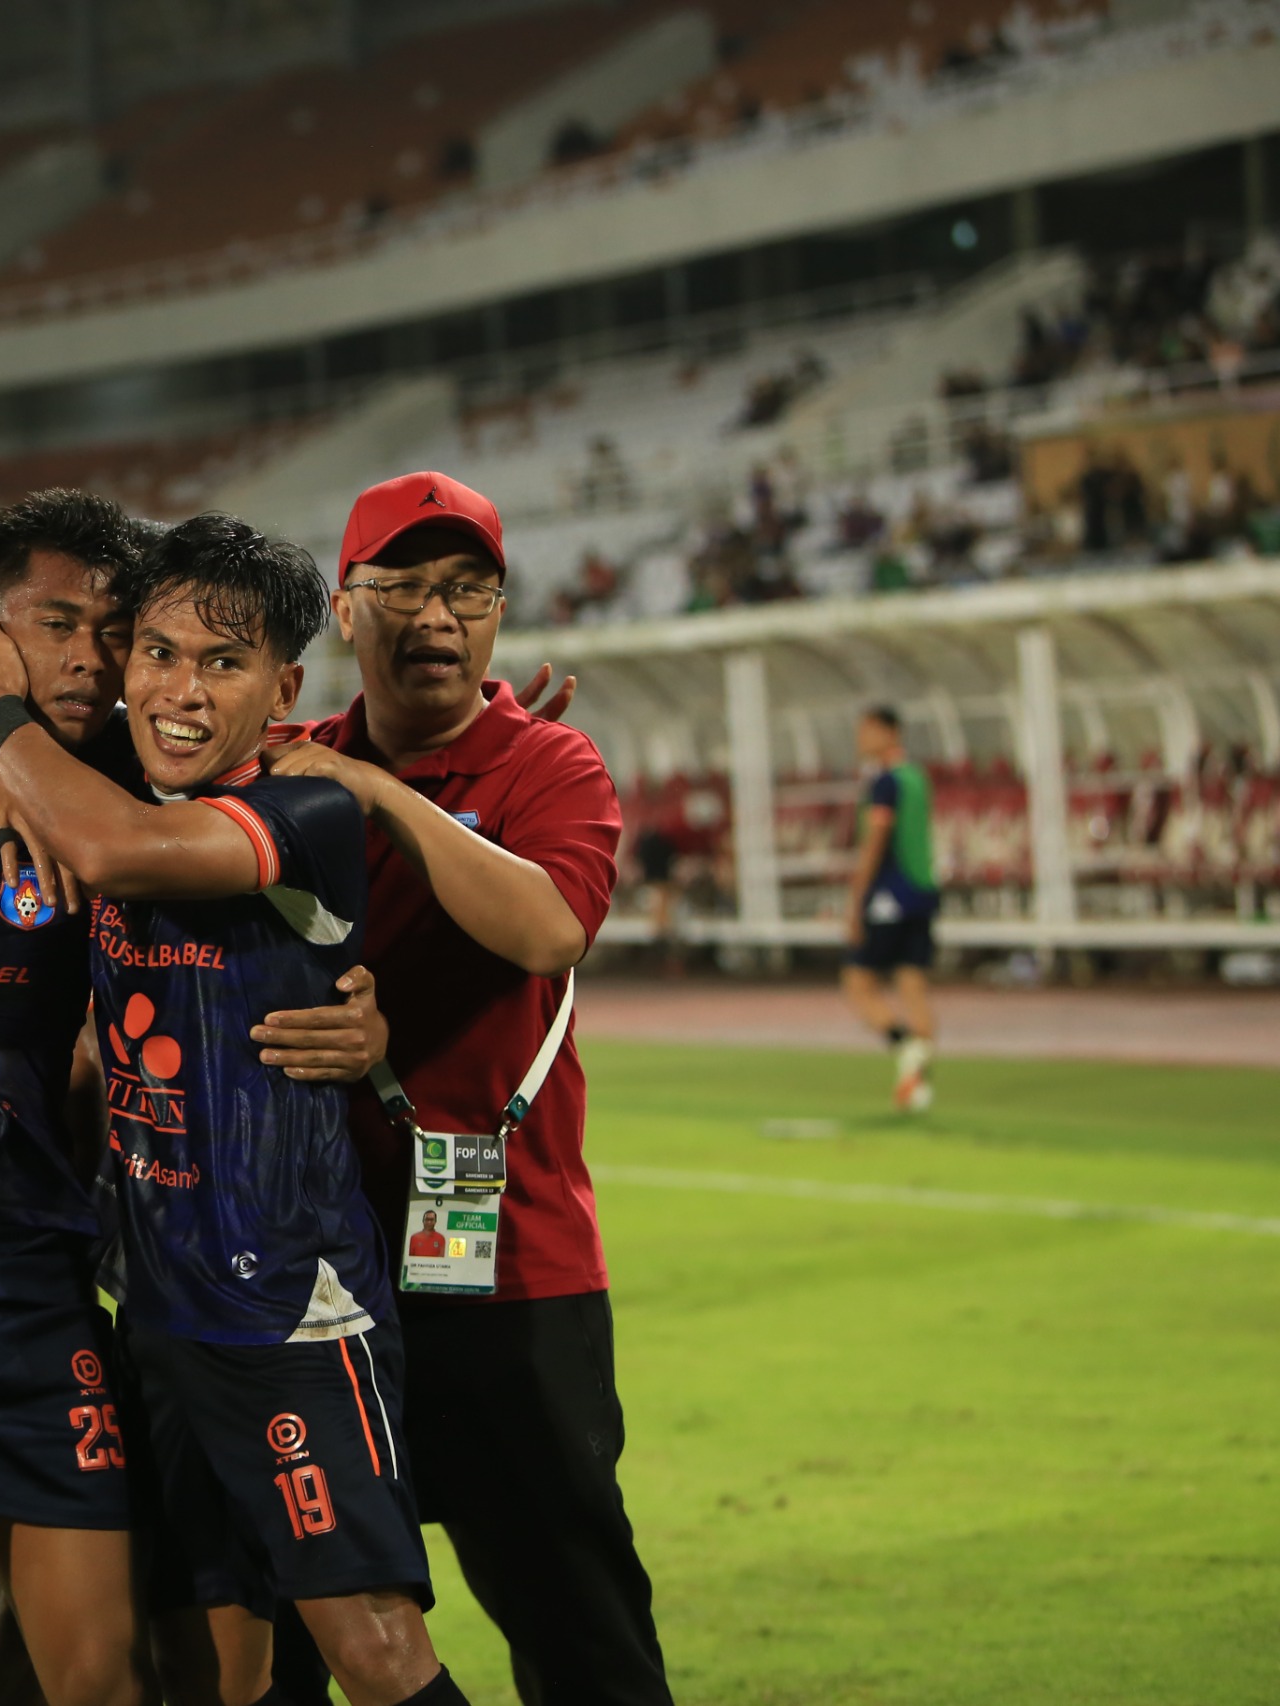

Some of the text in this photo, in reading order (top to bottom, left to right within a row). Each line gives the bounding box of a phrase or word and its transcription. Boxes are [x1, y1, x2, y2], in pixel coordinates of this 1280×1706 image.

[455, 1147, 499, 1160] FOP OA
[455, 1221, 486, 1230] OFFICIAL
[68, 1403, 126, 1472] 25
[275, 1449, 310, 1465] XTEN
[273, 1463, 337, 1540] 19
